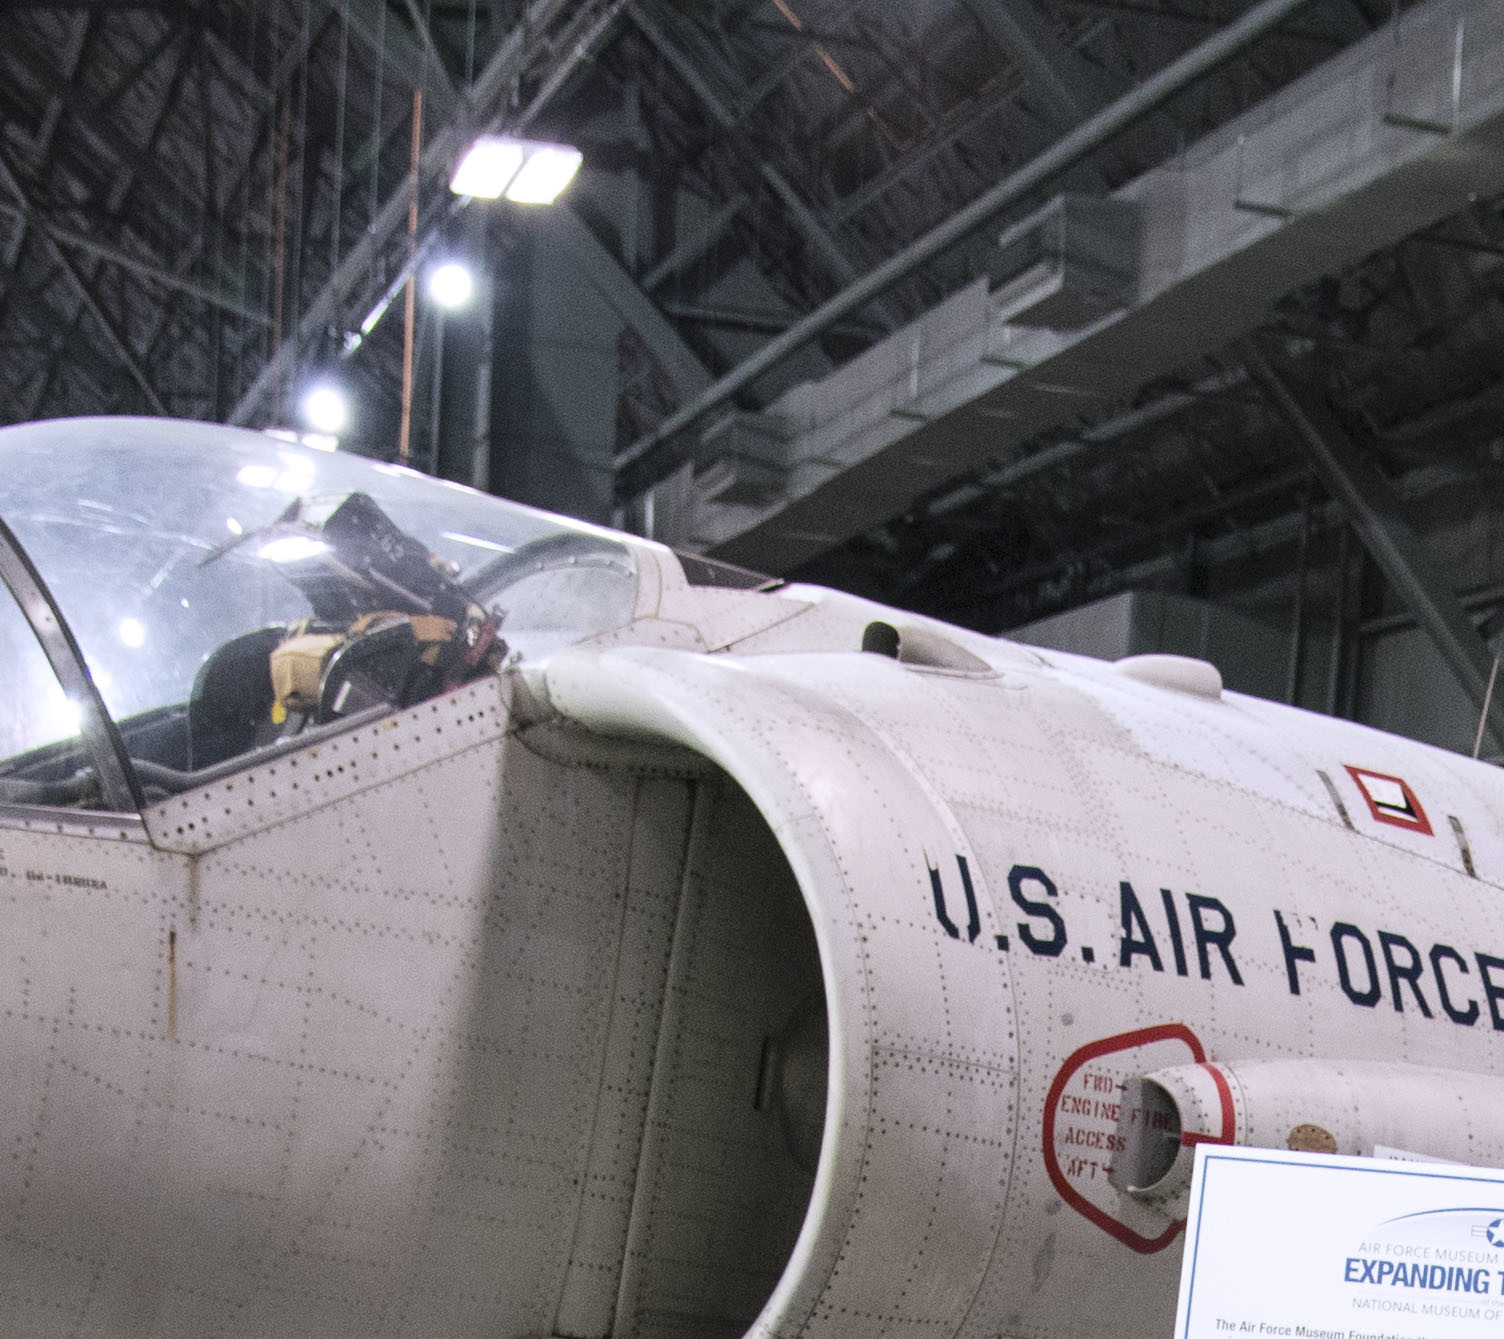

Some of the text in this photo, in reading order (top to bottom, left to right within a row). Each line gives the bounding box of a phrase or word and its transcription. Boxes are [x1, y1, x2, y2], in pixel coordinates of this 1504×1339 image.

[923, 846, 1094, 962] U.S.
[1119, 881, 1244, 985] AIR
[1083, 1073, 1113, 1093] FWD
[1061, 1095, 1173, 1130] ENGINE FIRE
[1065, 1127, 1126, 1151] ACCESS
[1067, 1159, 1098, 1179] AFT
[1357, 1240, 1381, 1254] AIR
[1384, 1242, 1430, 1259] FORCE
[1434, 1247, 1499, 1265] MUSEUM
[1343, 1256, 1491, 1294] EXPANDING
[1351, 1296, 1418, 1314] NATIONAL
[1420, 1302, 1481, 1320] MUSEUM
[1483, 1308, 1502, 1321] OF
[1214, 1317, 1236, 1331] The
[1239, 1320, 1256, 1333] Air
[1258, 1321, 1292, 1336] Force
